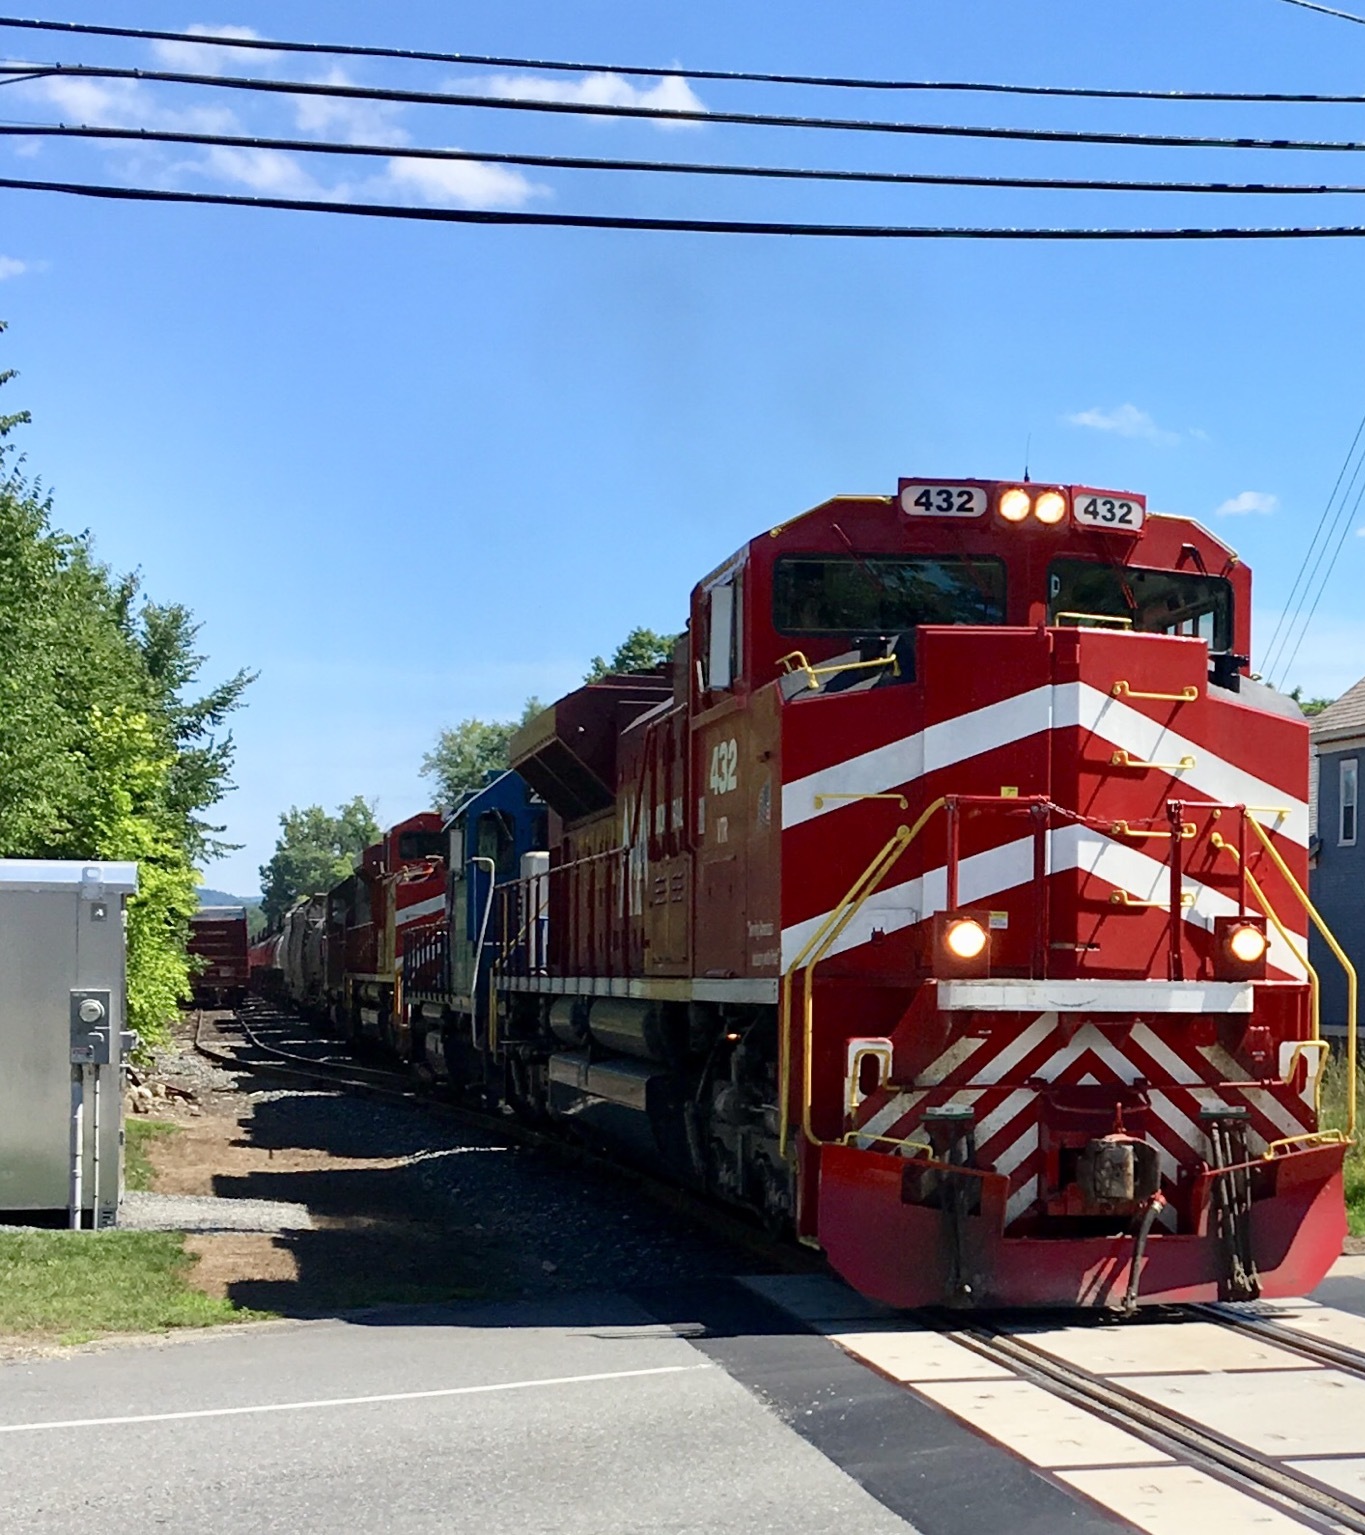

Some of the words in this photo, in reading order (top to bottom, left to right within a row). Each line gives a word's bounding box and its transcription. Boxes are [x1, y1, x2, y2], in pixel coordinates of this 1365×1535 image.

[914, 489, 974, 513] 432
[1083, 497, 1133, 525] 432
[709, 738, 738, 795] 432
